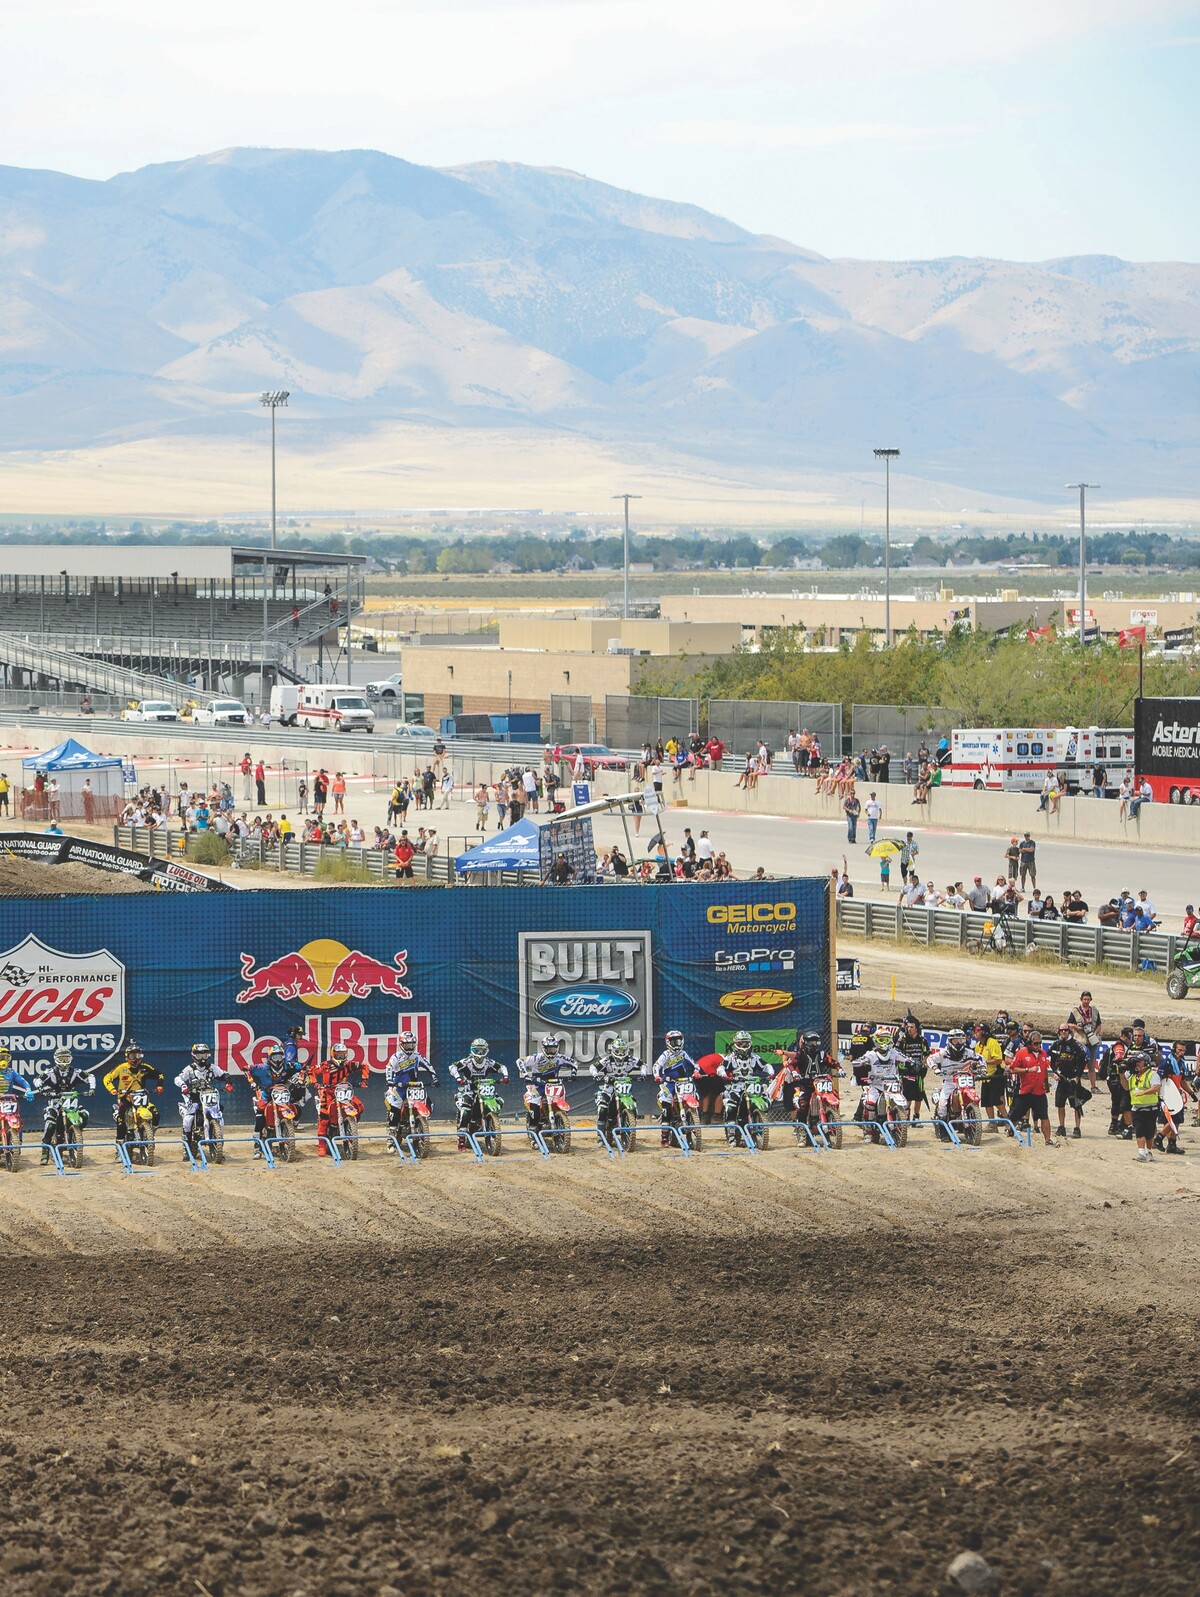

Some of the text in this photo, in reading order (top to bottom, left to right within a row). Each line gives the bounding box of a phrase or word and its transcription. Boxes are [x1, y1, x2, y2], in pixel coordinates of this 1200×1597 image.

[1152, 745, 1199, 758] MOBILE MEDICAL
[4, 840, 36, 850] NATIONAL
[37, 842, 61, 851] GUARD
[70, 845, 144, 870] AIR NATIONAL GUARD
[168, 866, 206, 886] LUCAS OIL
[706, 902, 796, 924] GEICO
[727, 921, 796, 934] Motorcycle
[531, 942, 641, 982] BUILT
[715, 948, 796, 966] GoPro
[38, 974, 118, 983] PERFORMANCE
[560, 994, 612, 1016] Ford
[720, 992, 793, 1008] FMF
[214, 1014, 322, 1076] Red
[725, 1042, 787, 1053] Kasaki
[480, 1086, 495, 1096] 292
[548, 1086, 562, 1096] 17
[616, 1084, 631, 1094] 317
[678, 1083, 693, 1094] 19
[746, 1084, 761, 1094] 40
[816, 1082, 832, 1092] 846
[886, 1082, 898, 1092] 76
[274, 1093, 290, 1104] 25
[336, 1090, 352, 1101] 94
[410, 1089, 424, 1100] 338
[62, 1098, 78, 1109] 44
[133, 1096, 148, 1106] 21
[0, 1102, 17, 1113] 127
